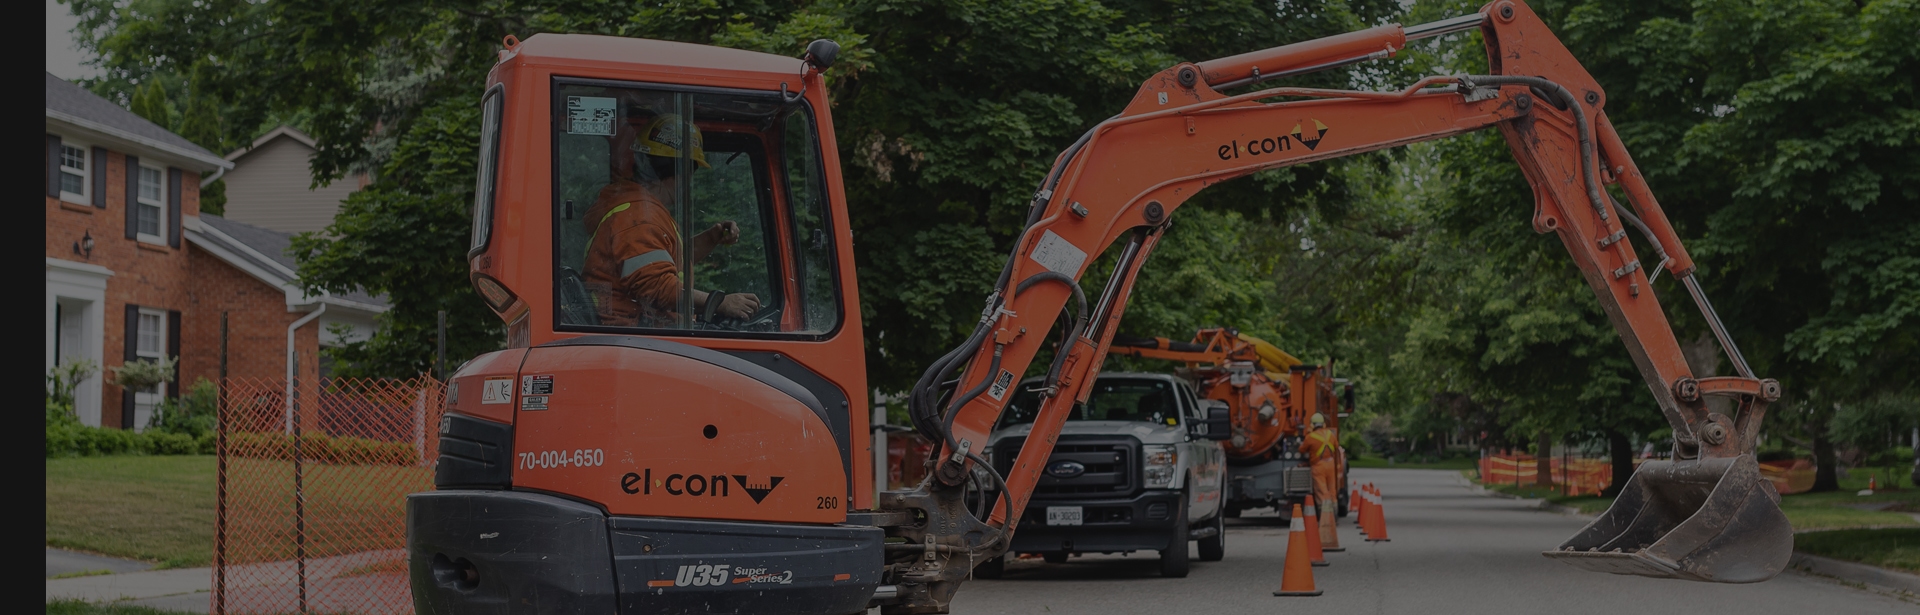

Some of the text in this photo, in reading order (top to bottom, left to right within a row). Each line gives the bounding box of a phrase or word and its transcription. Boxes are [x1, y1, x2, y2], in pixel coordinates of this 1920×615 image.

[518, 448, 604, 470] 70-004-650
[816, 496, 838, 510] 260
[675, 564, 730, 587] U35
[733, 566, 767, 577] Super
